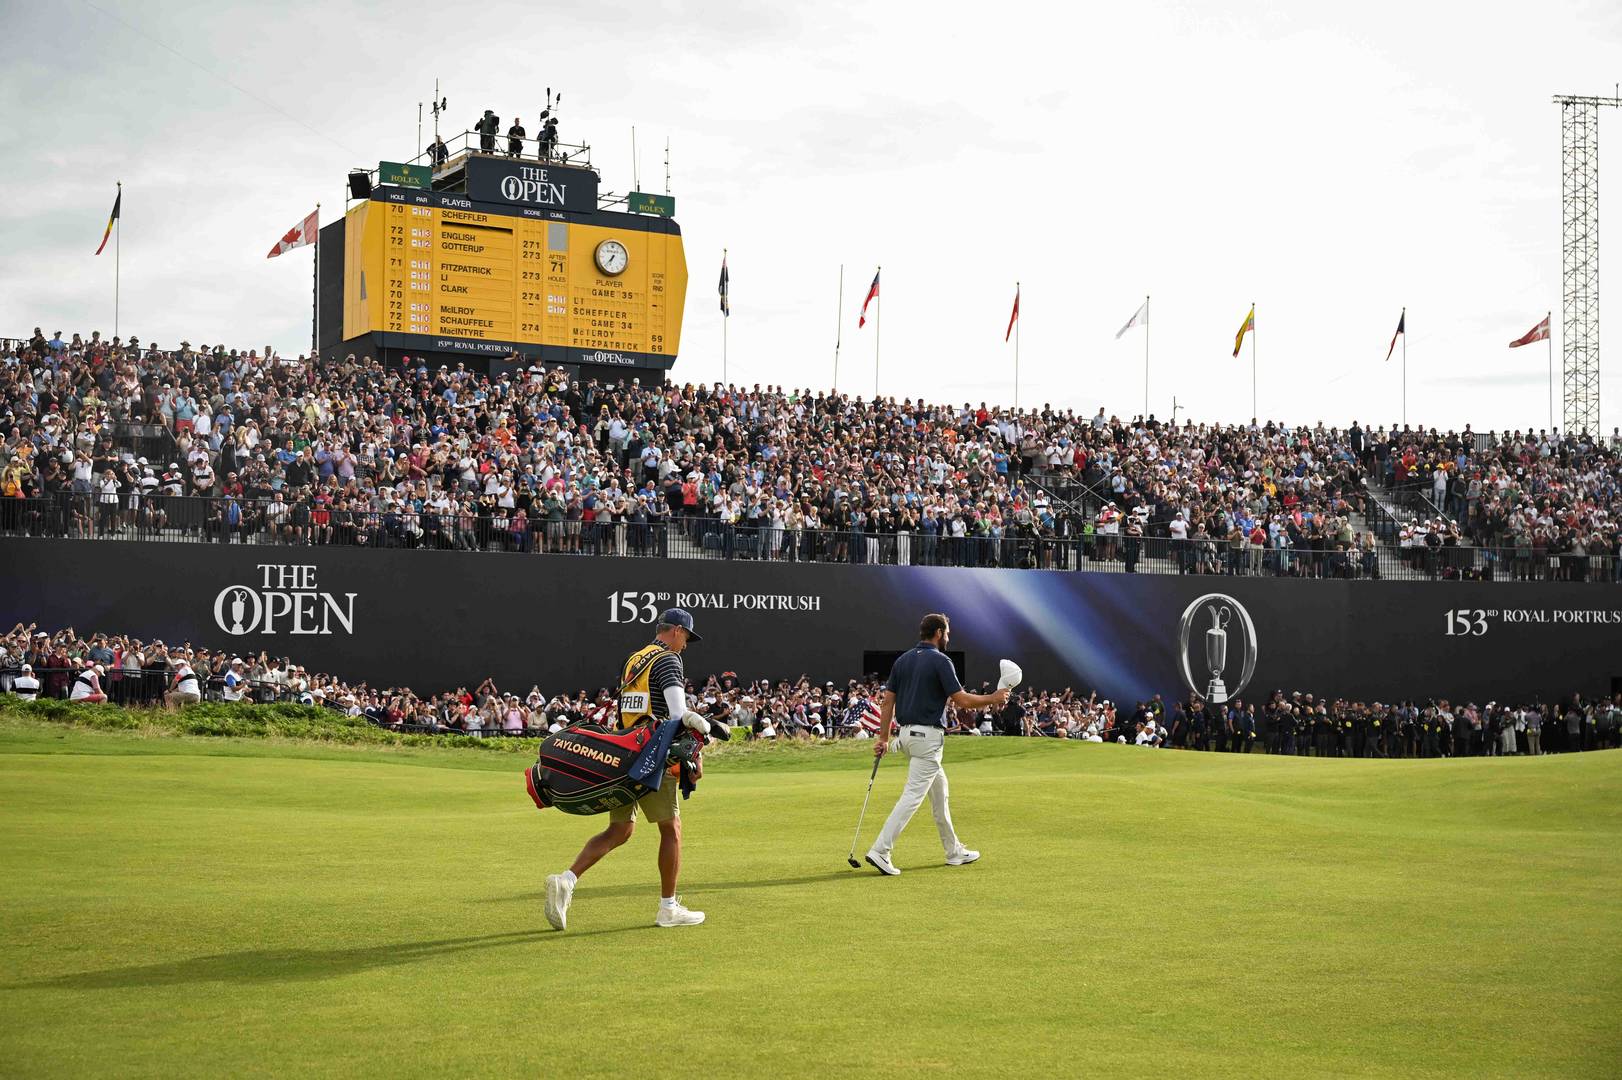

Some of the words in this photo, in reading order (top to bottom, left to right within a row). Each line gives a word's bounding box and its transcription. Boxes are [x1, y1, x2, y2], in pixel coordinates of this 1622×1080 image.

[391, 175, 421, 184] ROLEX
[520, 167, 548, 182] THE
[501, 176, 566, 205] OPEN
[442, 198, 471, 208] PLAYER
[639, 205, 664, 213] ROLEX
[442, 210, 488, 222] SCHEFFLER
[391, 226, 403, 234] 72
[442, 232, 476, 242] ENGLISH
[523, 240, 540, 249] 271
[391, 237, 403, 245] 72
[442, 243, 484, 253] GOTTERUP
[523, 251, 541, 259] 273
[441, 264, 492, 275] FITZPATRICK
[522, 272, 540, 280] 273
[551, 262, 564, 273] 71
[441, 285, 468, 294] CLARK
[596, 280, 623, 288] PLAYER
[592, 289, 615, 298] GAME
[440, 306, 475, 315] McILROY
[573, 308, 627, 319] SCHEFFLER
[390, 312, 402, 320] 72
[440, 316, 494, 327] SCHAUFFELE
[591, 320, 615, 328] GAME
[440, 327, 484, 337] MacINTYRE
[454, 342, 476, 350] ROYAL
[477, 343, 513, 353] PORTRUSH
[574, 339, 638, 350] FITZPATRICK
[257, 564, 318, 589] THE
[675, 592, 729, 608] ROYAL
[733, 594, 820, 610] PORTRUSH
[214, 585, 358, 635] OPEN
[1503, 609, 1549, 623] ROYAL
[1553, 610, 1622, 624] PORTRUS
[553, 738, 622, 768] TAYLORMADE
